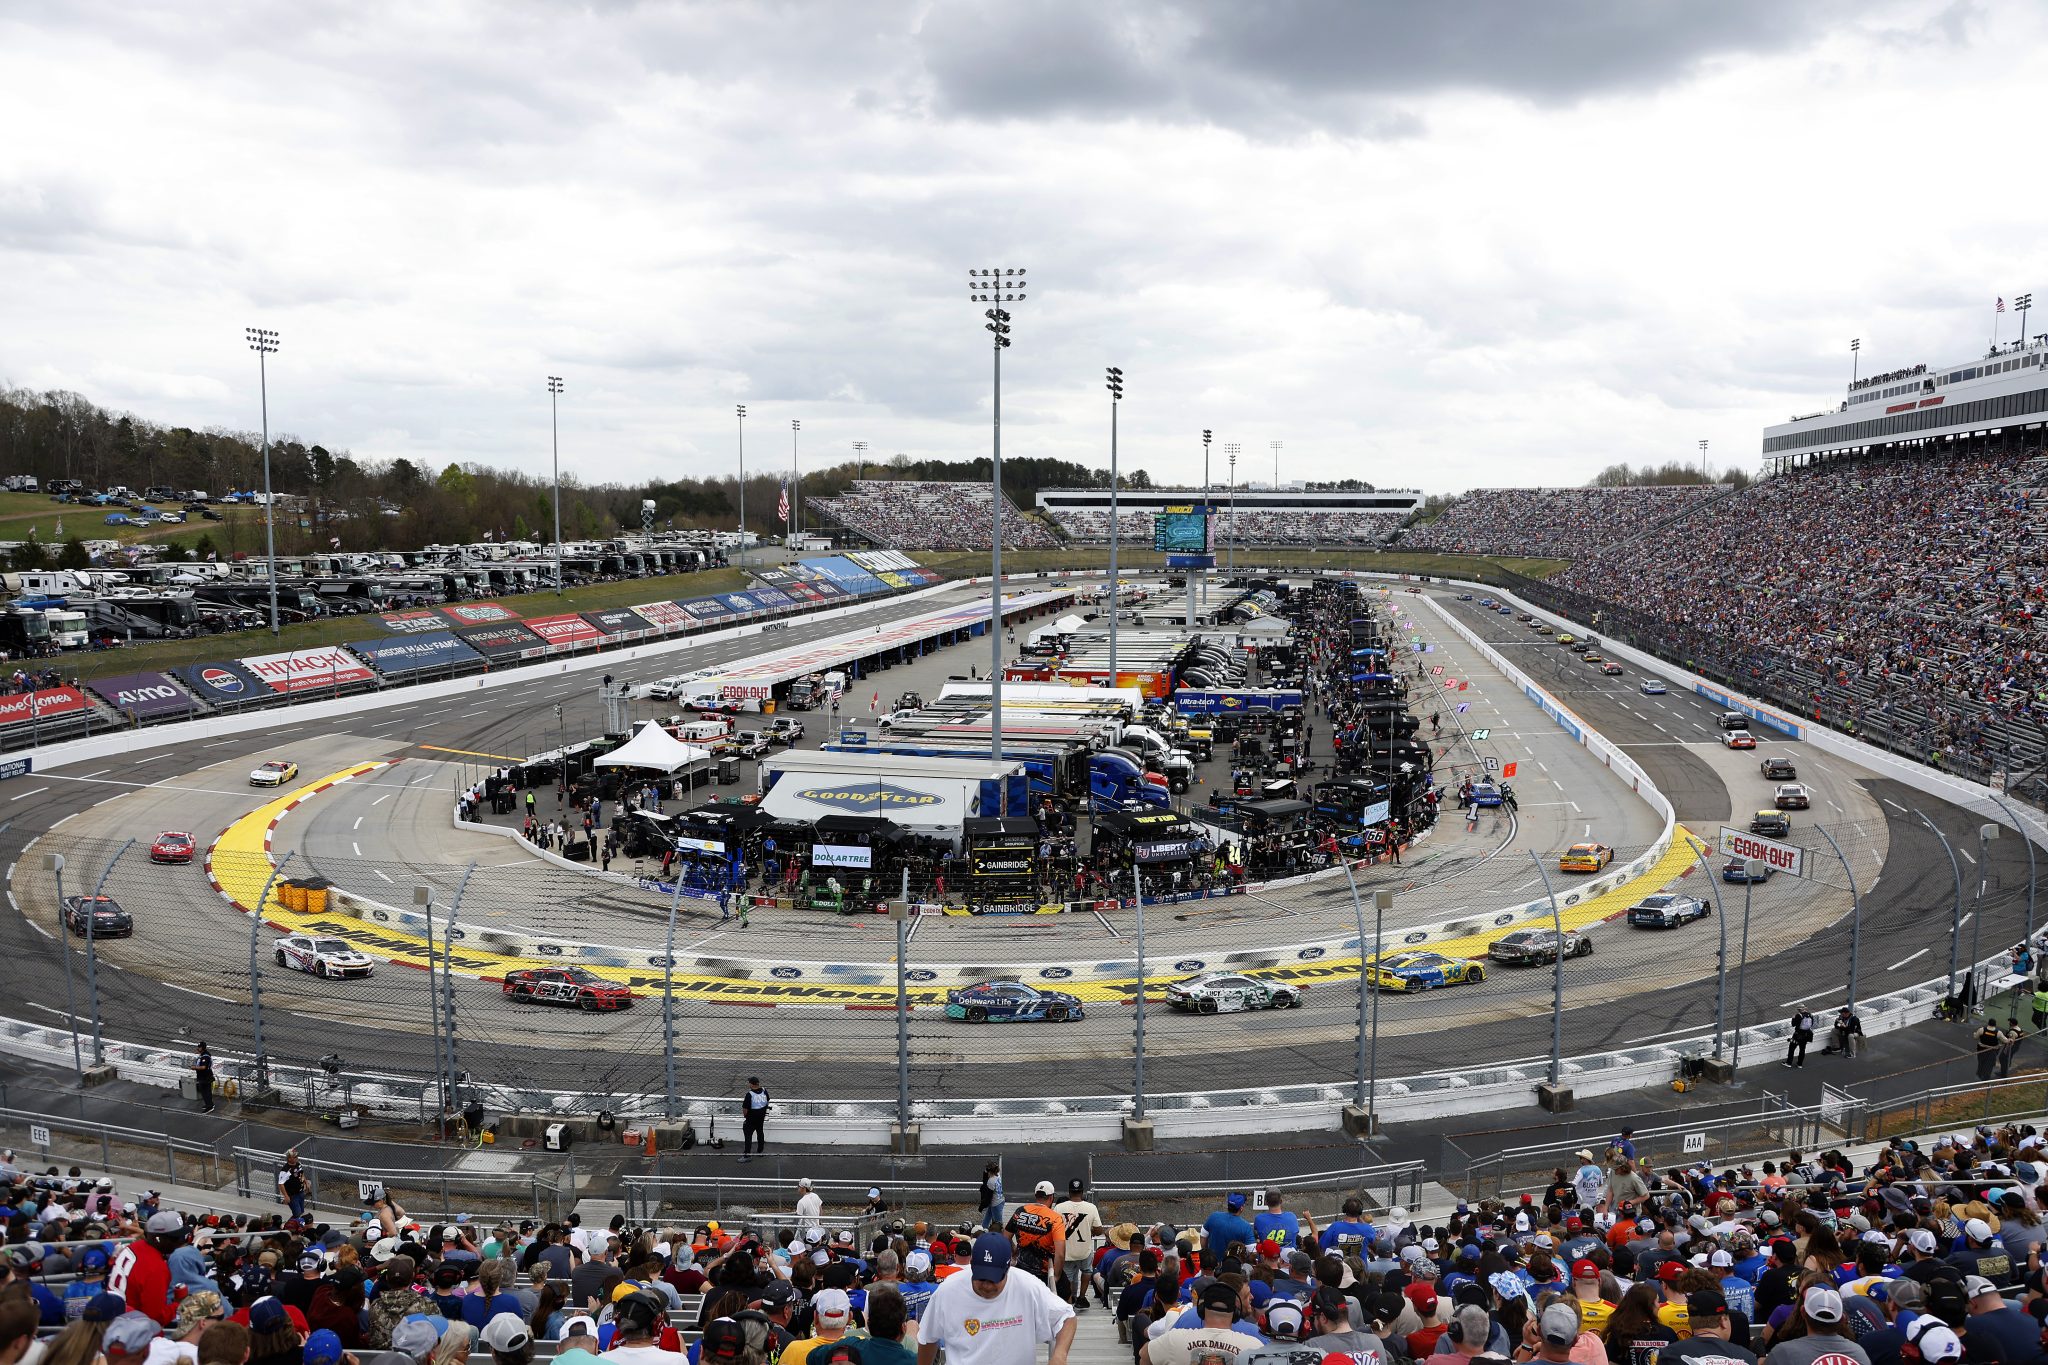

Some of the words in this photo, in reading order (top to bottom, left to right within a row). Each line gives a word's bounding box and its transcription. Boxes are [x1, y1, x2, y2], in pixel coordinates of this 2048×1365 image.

[386, 616, 445, 630] START
[375, 649, 407, 658] NASCAR
[407, 643, 431, 654] HALL
[434, 640, 460, 649] FAME
[252, 652, 351, 676] HITACHI
[208, 676, 240, 685] PEPSI
[285, 677, 308, 688] South
[308, 675, 333, 685] Boston
[335, 671, 360, 682] Virginia
[723, 686, 750, 699] COOK
[750, 686, 769, 699] OUT
[0, 701, 27, 715] sse
[23, 692, 72, 716] Jones
[1471, 729, 1490, 741] 54
[0, 760, 26, 772] NATIONAL
[803, 790, 935, 804] GOODYEAR
[1466, 803, 1478, 820] 1
[1366, 831, 1384, 843] 66
[1151, 842, 1188, 853] LIBERTY
[1734, 837, 1768, 863] COOK
[1769, 848, 1795, 869] OUT
[814, 853, 848, 862] DOLLAR
[848, 855, 870, 863] TREE
[1229, 845, 1241, 865] 24
[986, 861, 1029, 869] GAINBRIDGE
[982, 904, 1036, 914] GAINBRIDGE
[541, 945, 560, 955] Ford
[1564, 939, 1575, 951] 3
[1302, 949, 1321, 959] Ford
[1179, 961, 1201, 971] Ford
[776, 968, 797, 978] Ford
[911, 971, 932, 980] Ford
[1044, 969, 1068, 978] Ford
[997, 998, 1012, 1006] Life
[1015, 998, 1040, 1015] 77
[33, 1129, 47, 1142] EEE
[1686, 1137, 1702, 1148] AAA
[1582, 1181, 1600, 1189] BUSCH
[1018, 1212, 1050, 1227] SRX
[1266, 1229, 1286, 1243] 48
[984, 1249, 993, 1263] LA
[108, 1246, 136, 1299] 8
[1187, 1340, 1207, 1351] JACK
[1208, 1340, 1241, 1356] DANIEL'S
[1944, 1342, 1954, 1354] 5
